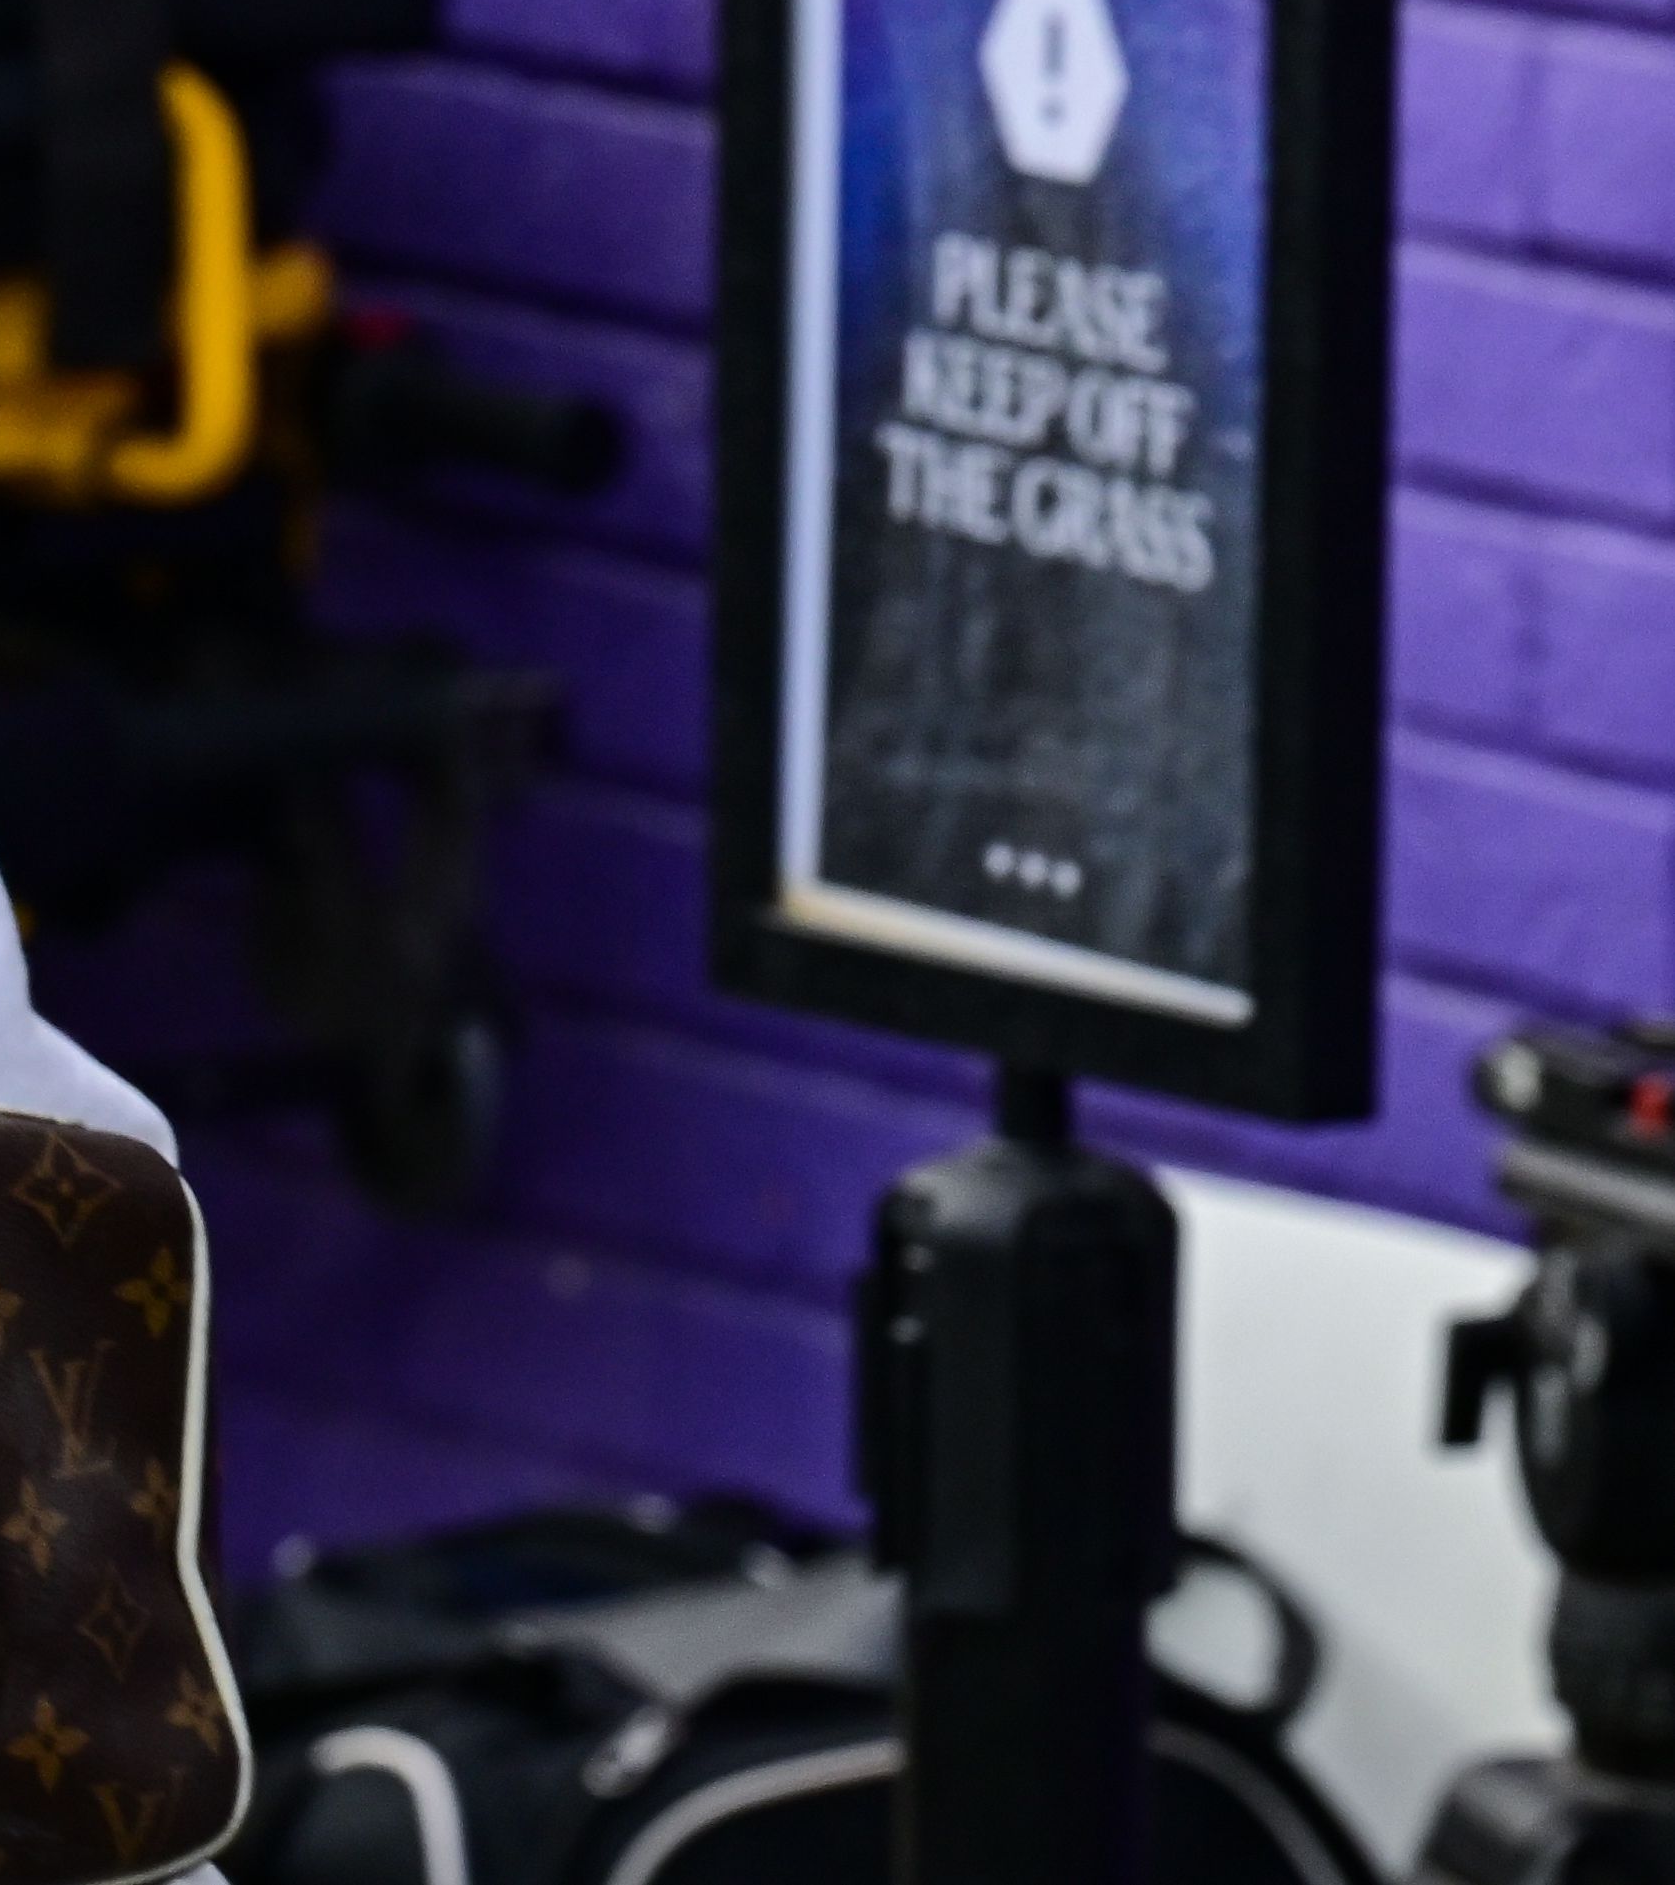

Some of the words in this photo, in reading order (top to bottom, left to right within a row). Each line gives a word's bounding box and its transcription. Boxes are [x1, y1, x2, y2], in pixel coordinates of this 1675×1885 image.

[933, 229, 1170, 373] PLEASE
[902, 327, 1067, 450] KEEP
[1065, 368, 1197, 478] OFF
[874, 419, 1011, 545] THE
[1011, 454, 1216, 593] GRASS
